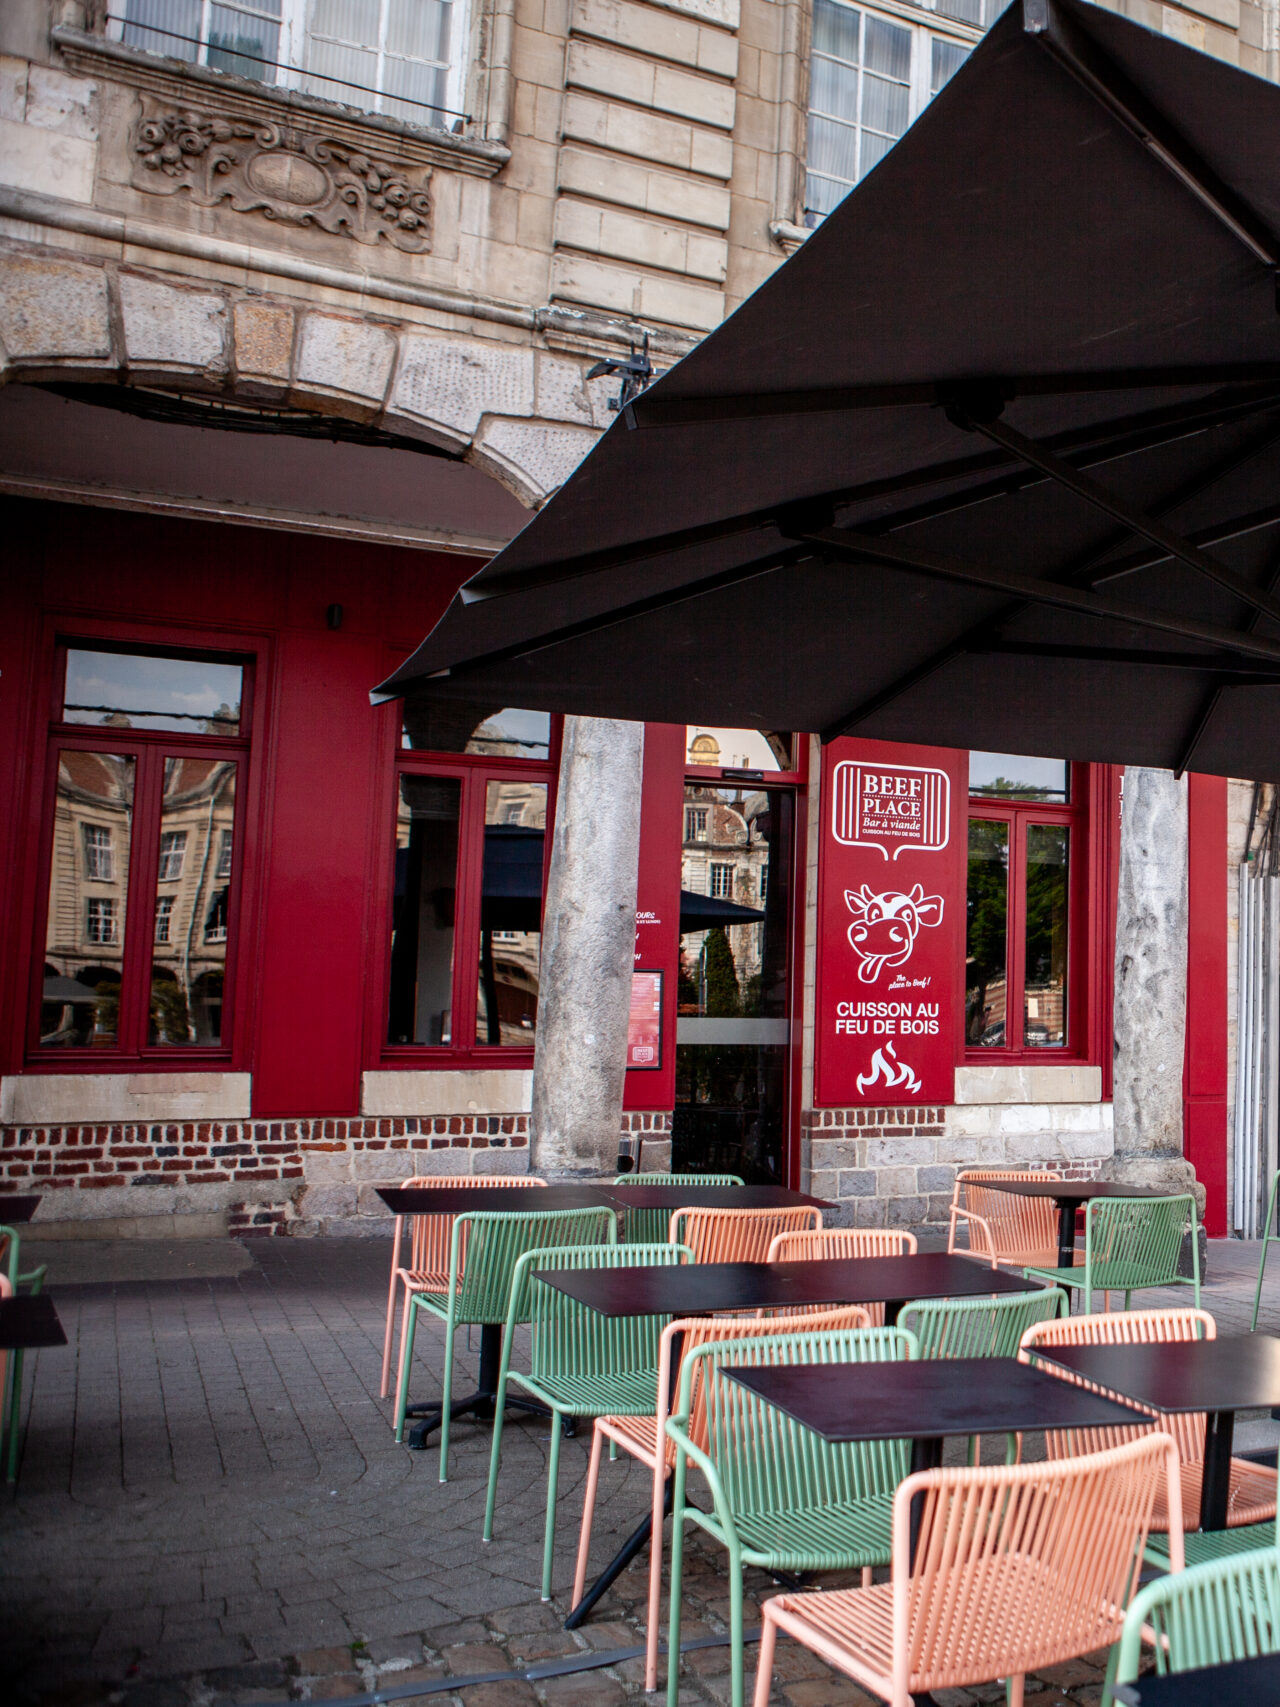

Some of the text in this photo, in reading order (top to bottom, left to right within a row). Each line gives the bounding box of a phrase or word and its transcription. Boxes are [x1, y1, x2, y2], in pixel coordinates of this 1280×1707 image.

[863, 774, 922, 798] BEEF
[863, 798, 921, 817] PLACE
[863, 817, 921, 831] Bar à viande
[635, 911, 656, 919] OURS
[836, 1002, 940, 1018] CUISSON AU
[835, 1020, 940, 1035] FEU DE BOIS
